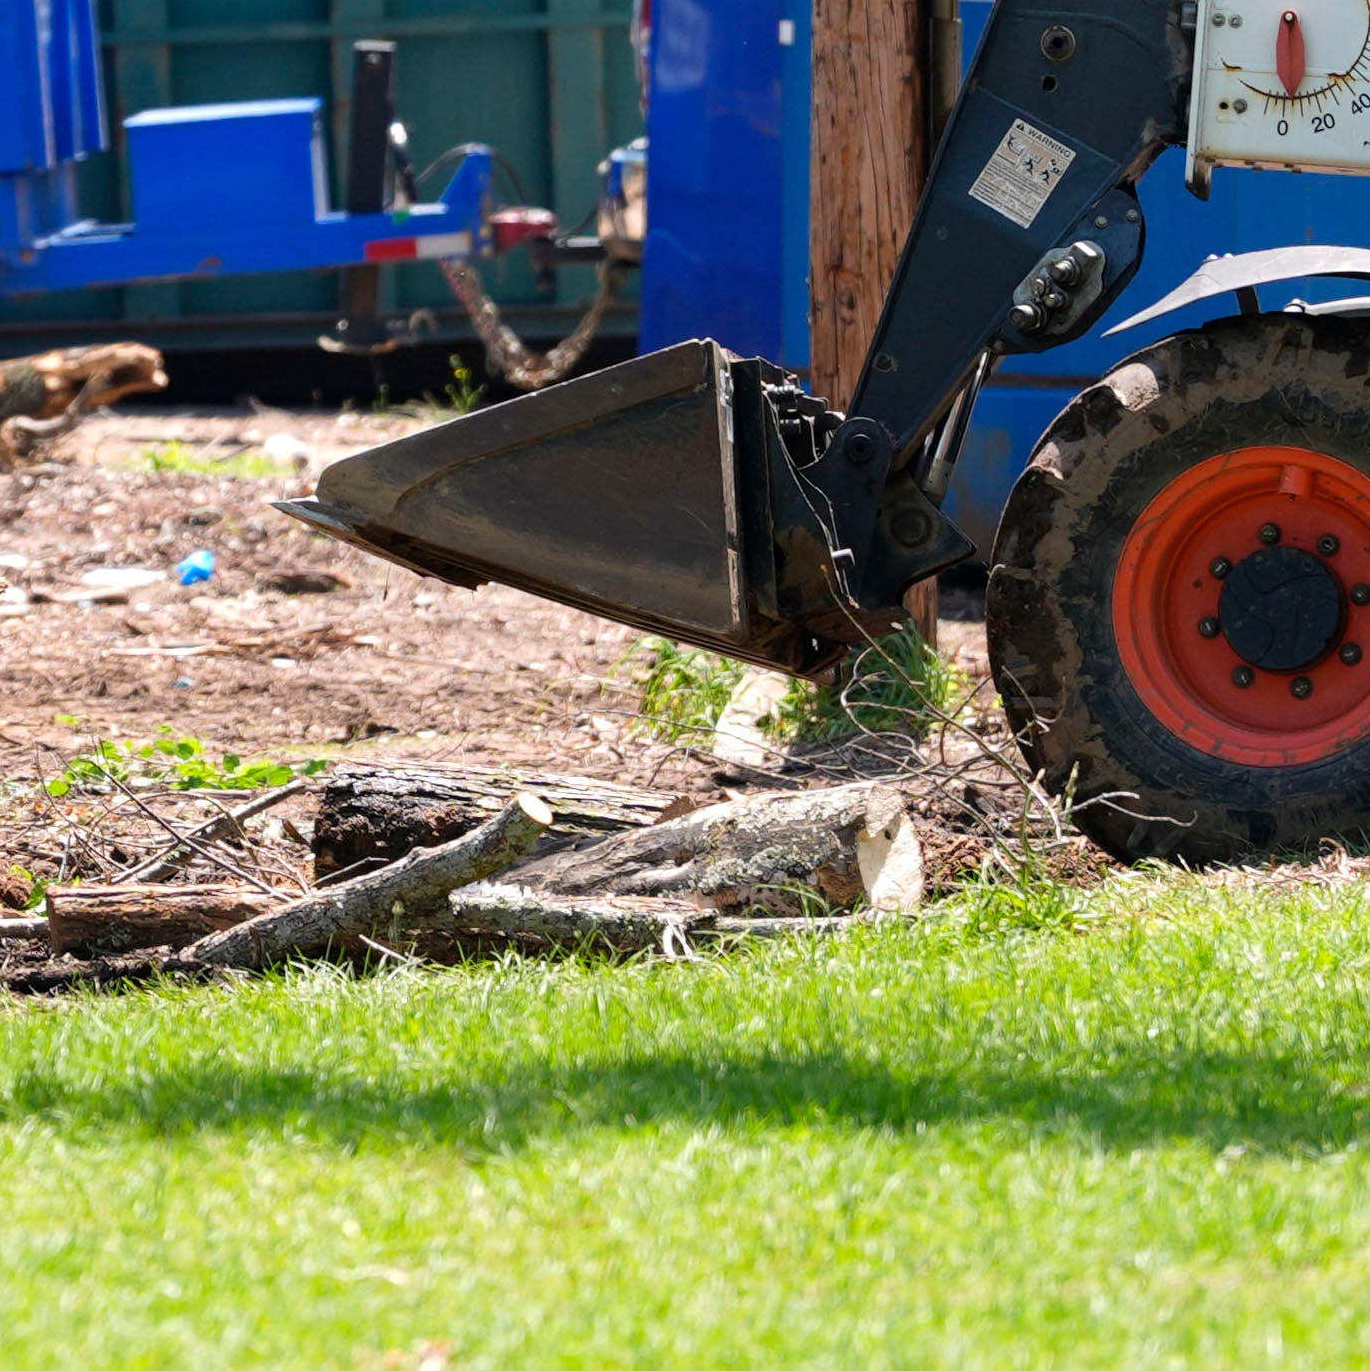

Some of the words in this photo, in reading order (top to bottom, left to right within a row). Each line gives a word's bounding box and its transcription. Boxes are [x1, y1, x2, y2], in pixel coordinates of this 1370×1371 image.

[1277, 120, 1289, 136] 0
[1311, 113, 1336, 134] 20
[1028, 128, 1071, 158] WARNING
